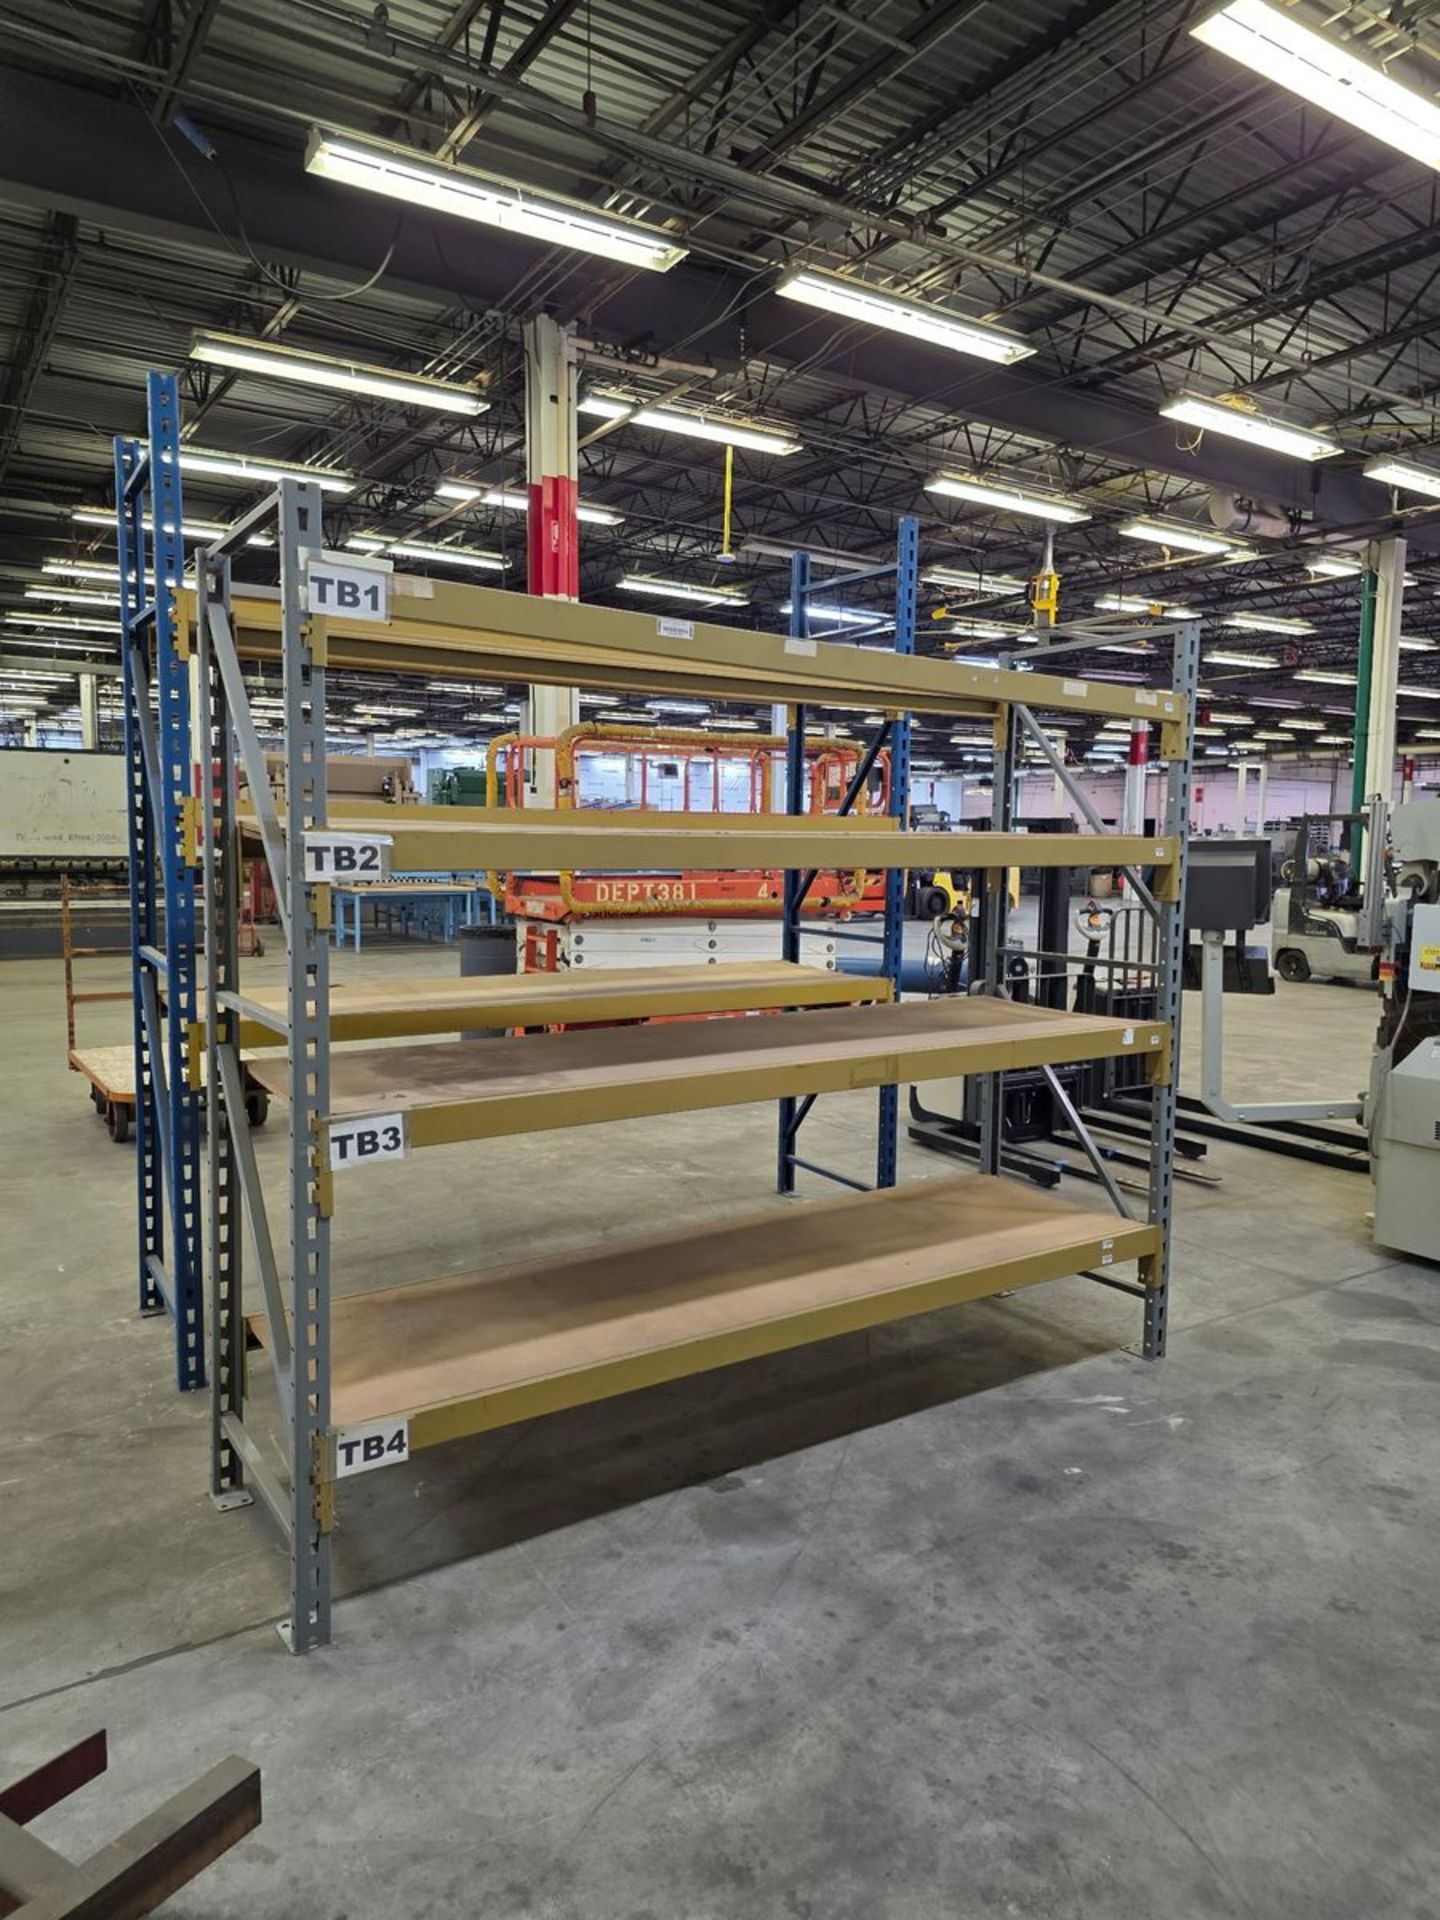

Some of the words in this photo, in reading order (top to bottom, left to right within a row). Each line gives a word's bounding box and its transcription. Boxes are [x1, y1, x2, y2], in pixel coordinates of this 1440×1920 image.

[310, 575, 379, 612] TB1
[306, 845, 379, 871] TB2
[331, 1126, 401, 1159] TB3
[338, 1429, 406, 1466] TB4
